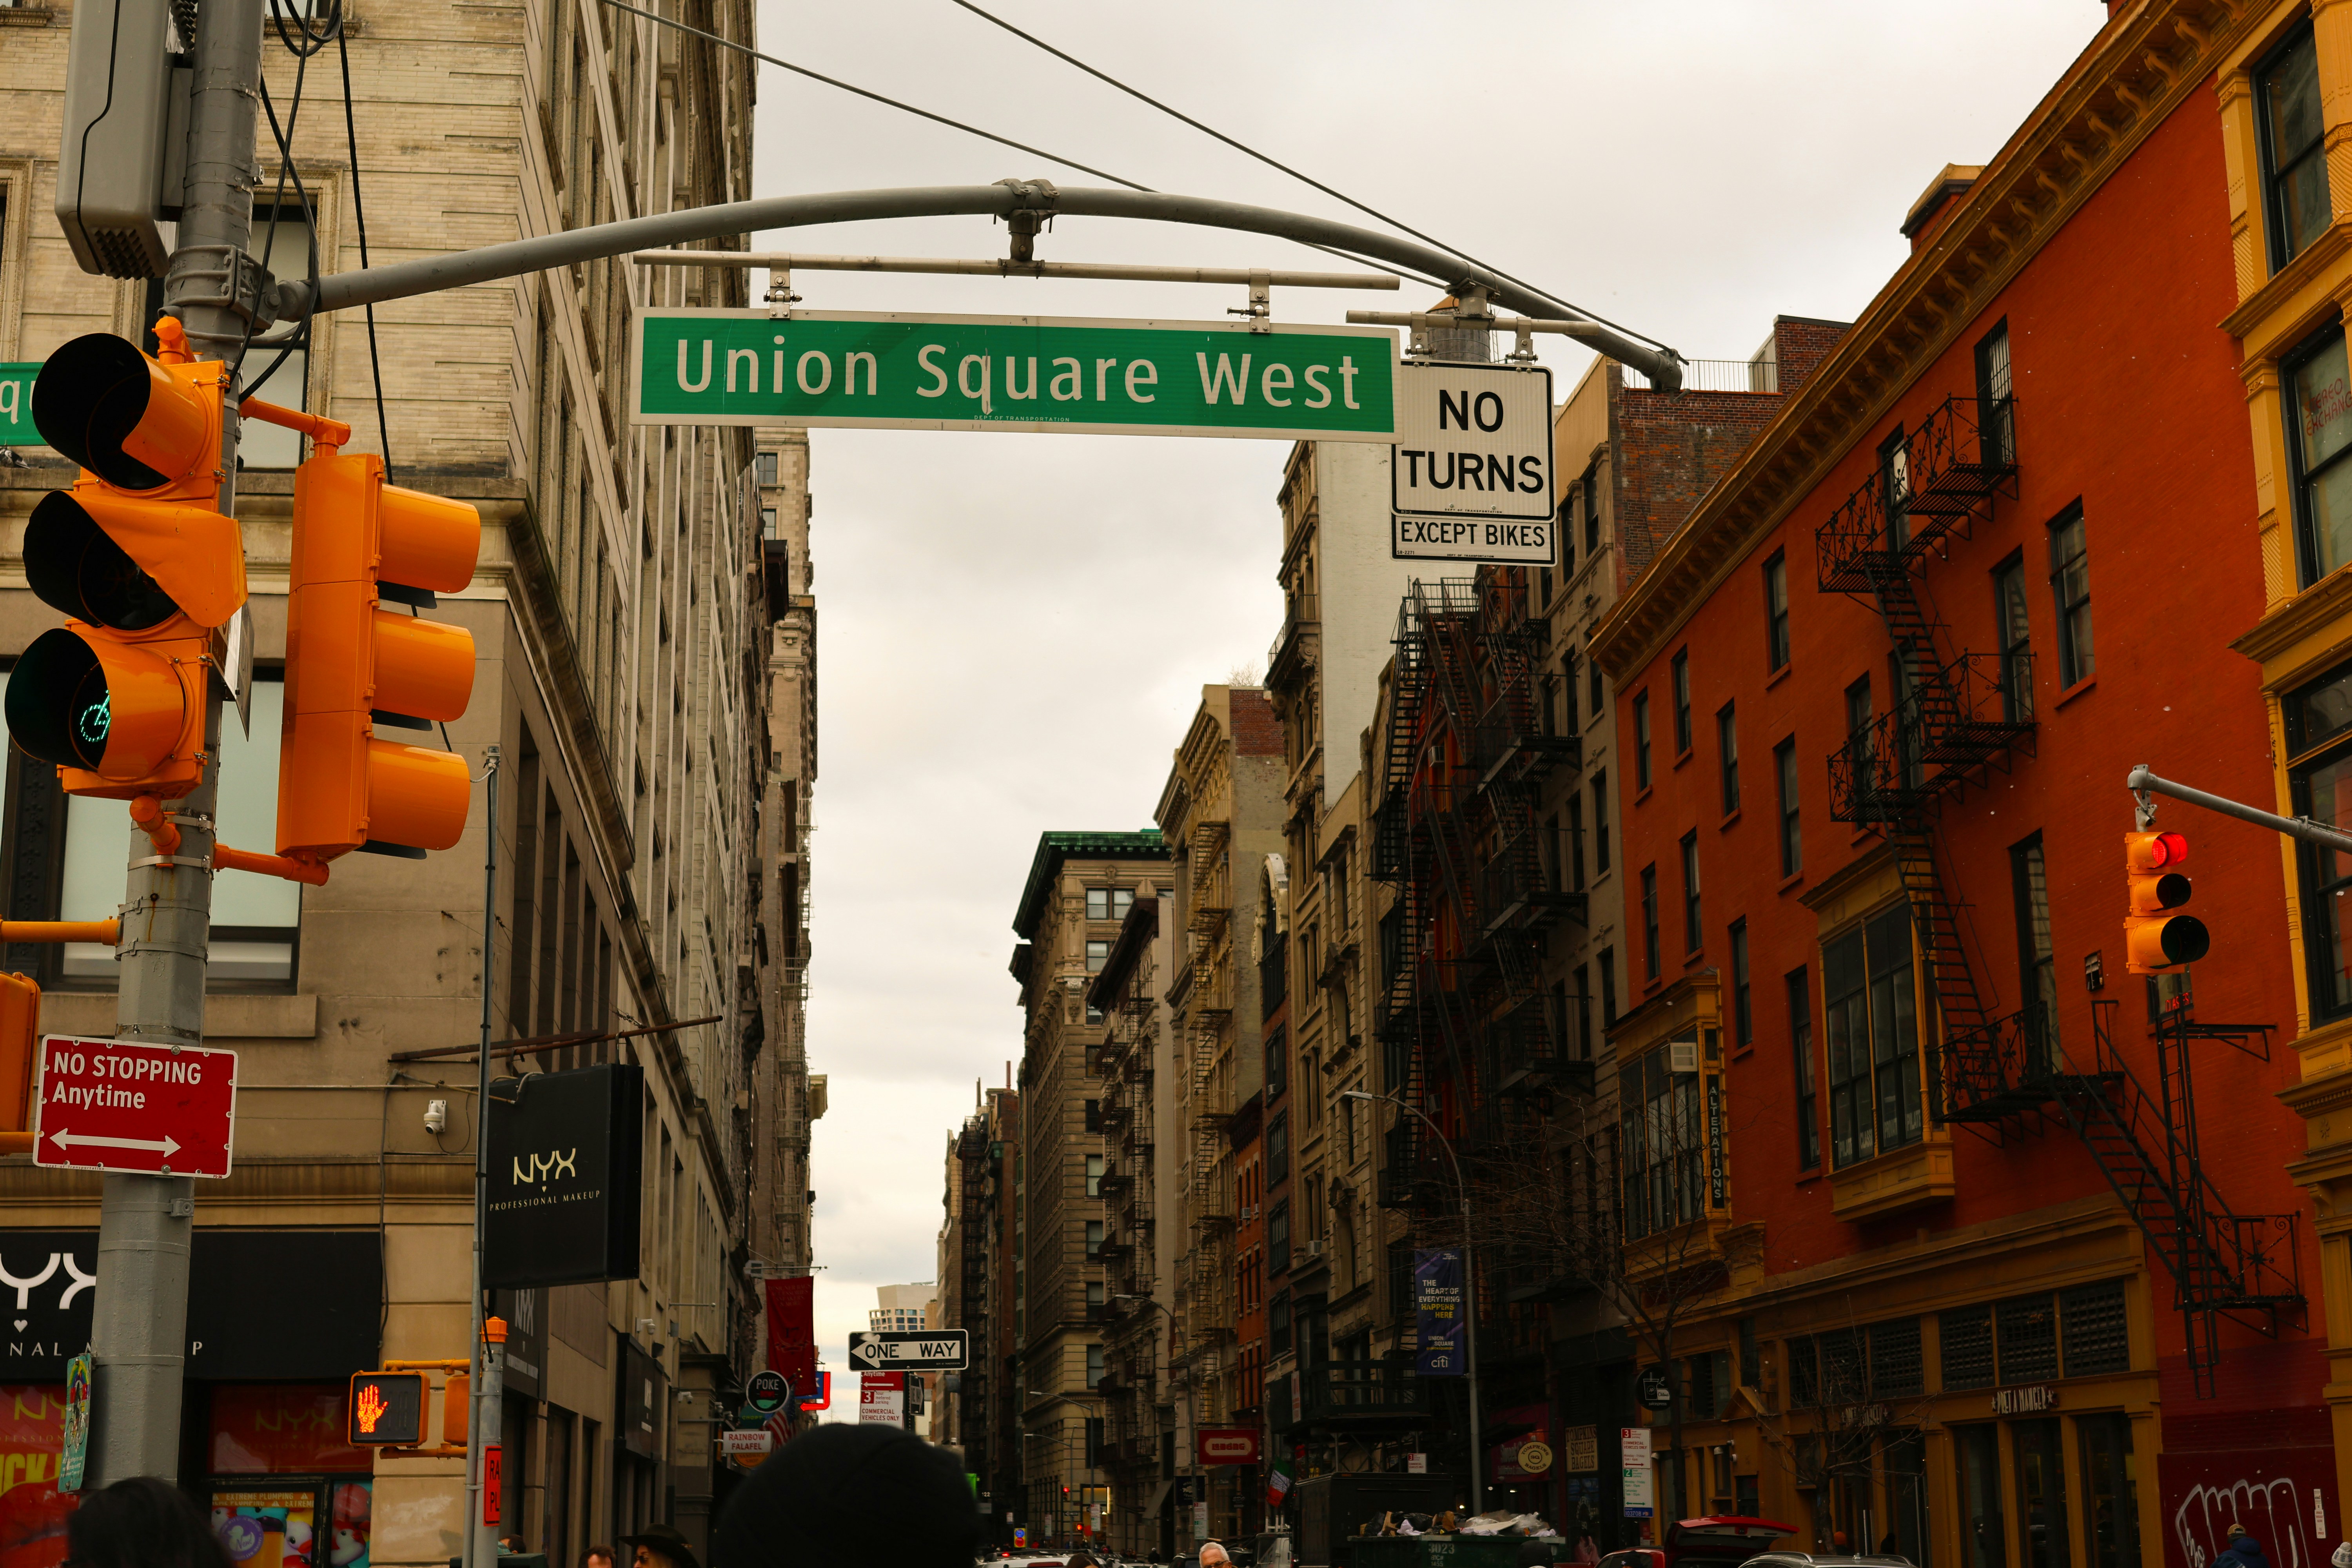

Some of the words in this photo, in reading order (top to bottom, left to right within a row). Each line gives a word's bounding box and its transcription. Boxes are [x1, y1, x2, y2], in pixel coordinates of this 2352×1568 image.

[677, 335, 877, 395] Union
[916, 344, 1158, 415] Square
[1196, 352, 1360, 410] West
[1439, 390, 1504, 432] NO
[1401, 450, 1544, 494] TURNS
[1401, 521, 1477, 544] EXCEPT
[1486, 524, 1545, 547] BIKES
[53, 1051, 85, 1075] NO
[92, 1055, 201, 1085] STOPPING
[52, 1081, 146, 1110] Anytime
[1708, 1086, 1722, 1199] ALTERATIONS
[514, 1148, 576, 1185] NYX
[490, 1196, 557, 1211] PROFESSIONAL
[563, 1190, 600, 1202] MAKEUP
[865, 1344, 899, 1358] ONE
[920, 1343, 956, 1357] WAY
[756, 1379, 779, 1390] POKE
[864, 1392, 871, 1403] 3
[255, 1408, 336, 1432] NYX
[1566, 1425, 1597, 1443] TOMPKINS
[1521, 1445, 1549, 1456] TOMPKINS
[1571, 1441, 1595, 1455] SQUARE
[1572, 1455, 1595, 1470] BAGELS
[226, 1493, 257, 1501] EXTREME
[259, 1492, 294, 1501] PLUMPING
[1428, 1543, 1455, 1555] 3023
